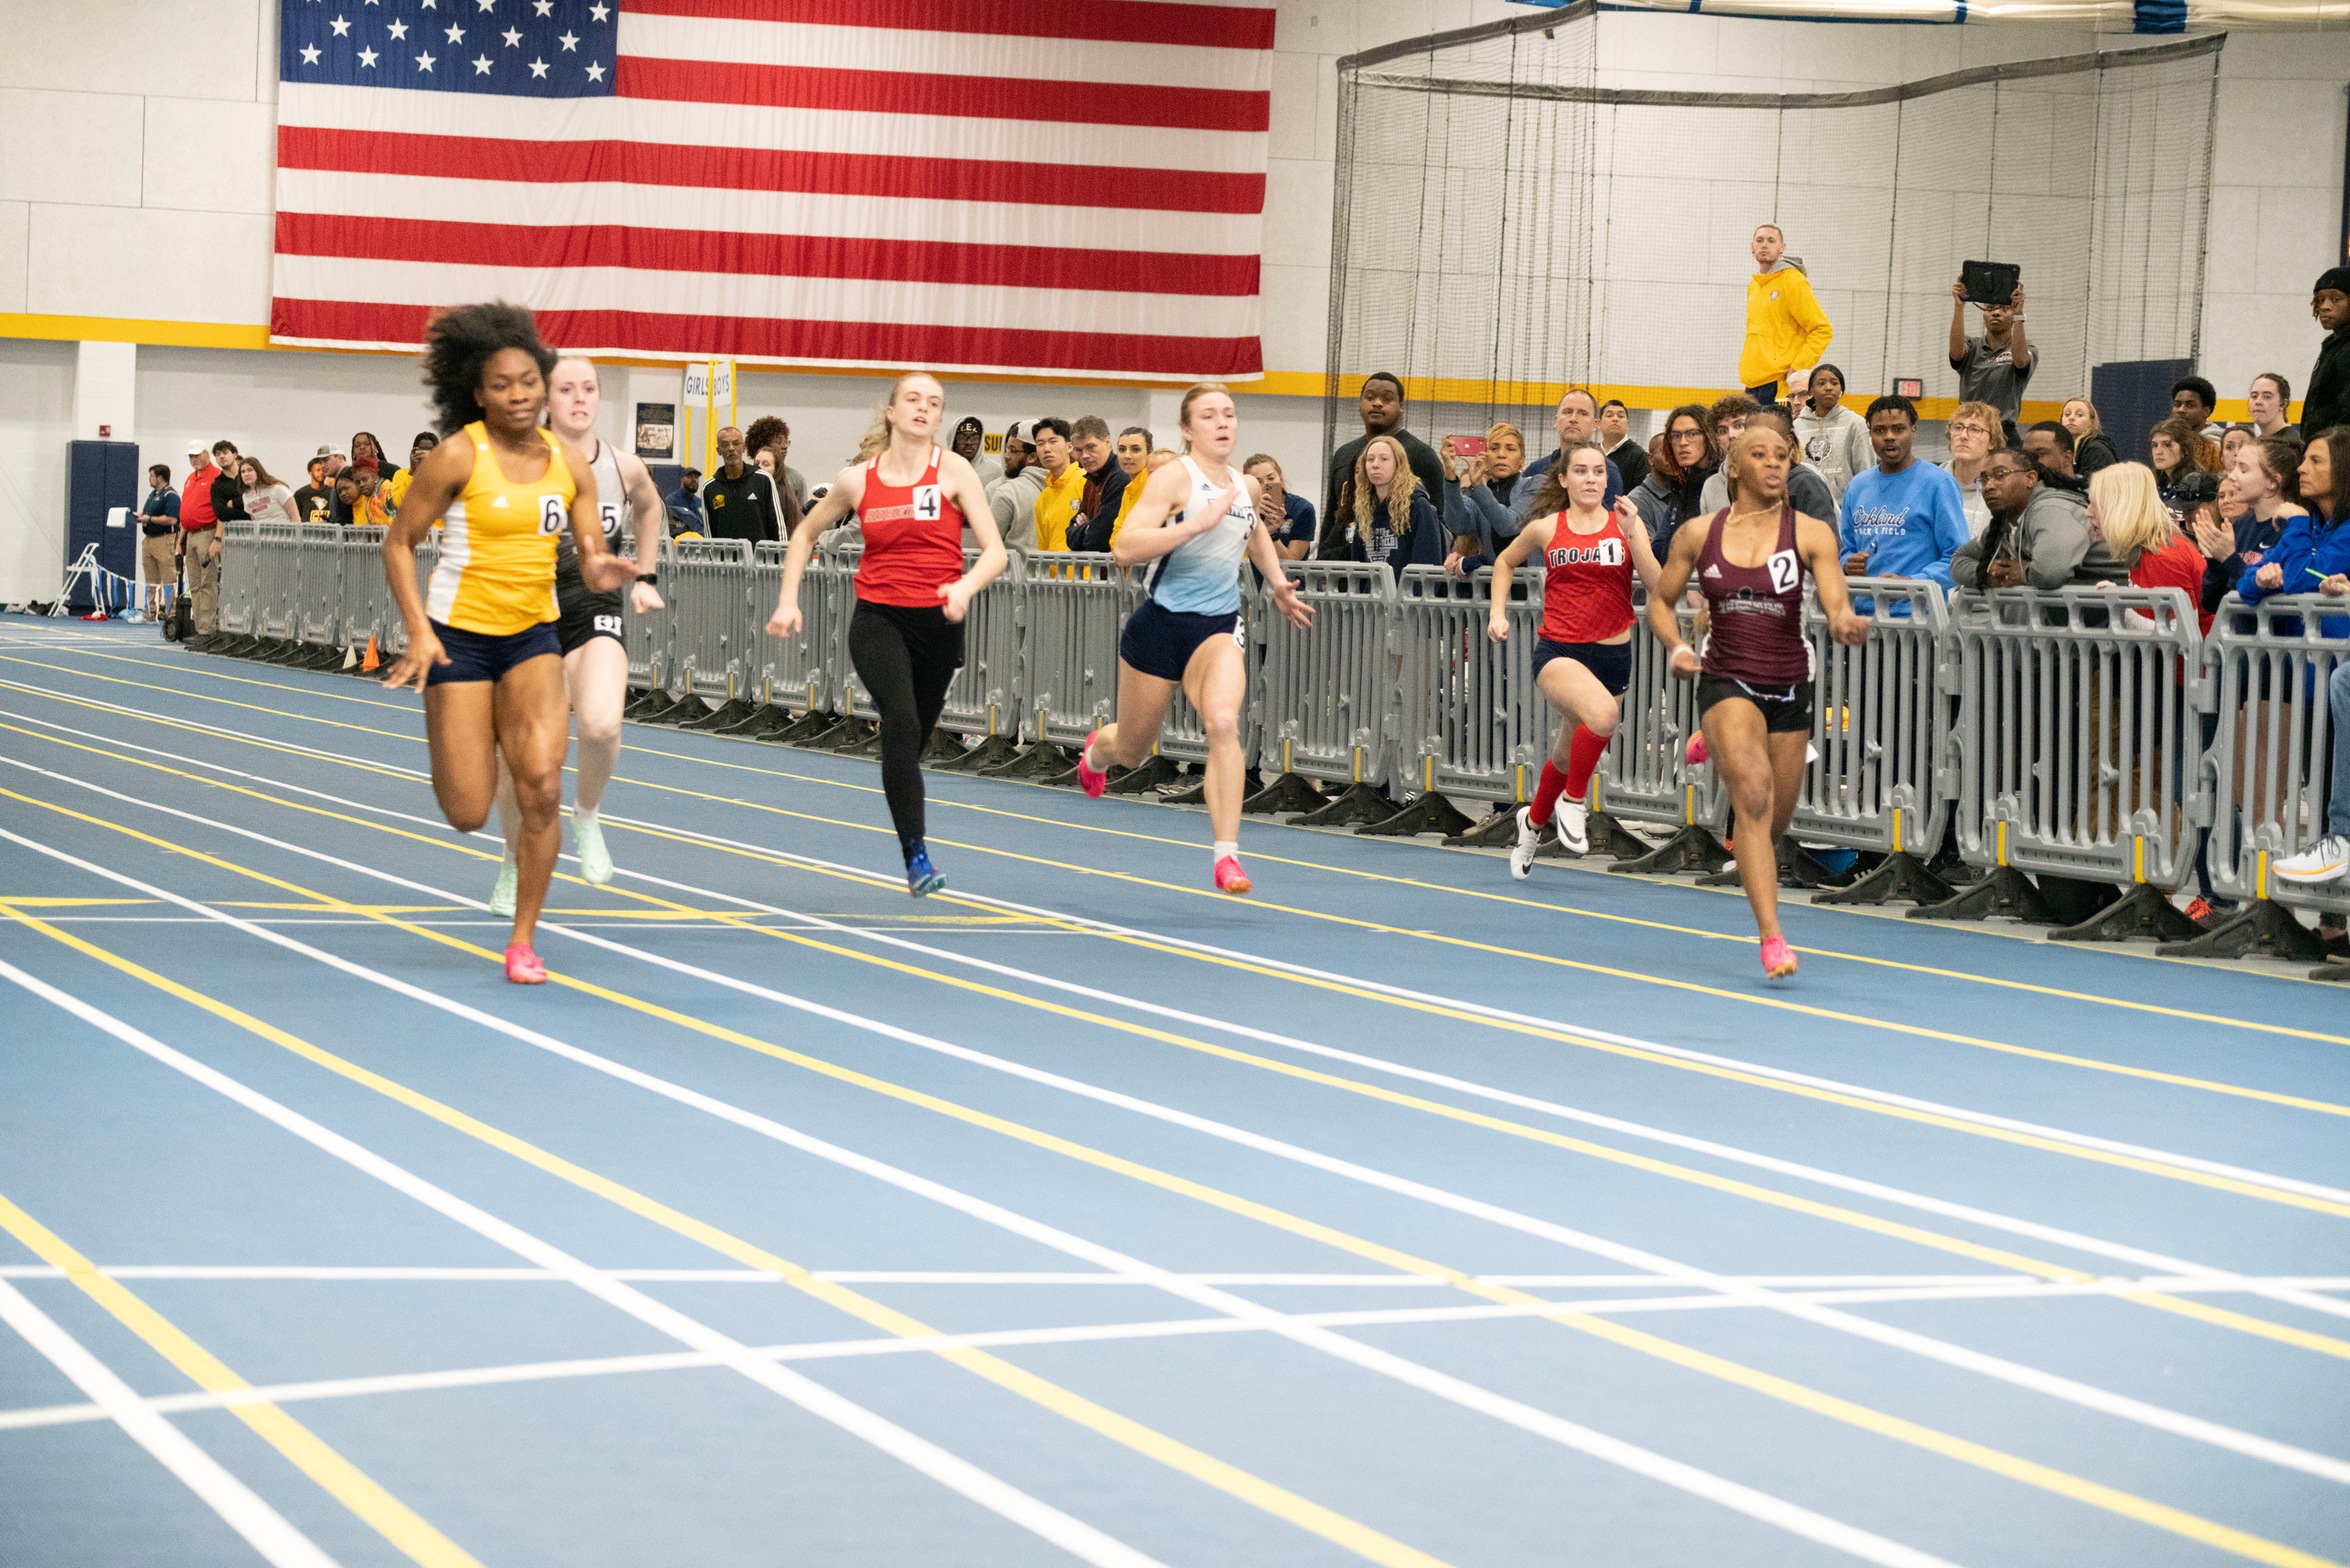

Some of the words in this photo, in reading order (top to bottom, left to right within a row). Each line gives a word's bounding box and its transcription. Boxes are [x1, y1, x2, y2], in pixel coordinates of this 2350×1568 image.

[686, 376, 709, 396] GIRLS
[919, 488, 937, 517] 4
[544, 499, 560, 533] 6
[602, 506, 616, 534] 5
[1853, 505, 1909, 527] Oakland
[1548, 547, 1626, 569] TROJA
[1608, 542, 1614, 563] 1
[1773, 557, 1795, 588] 2
